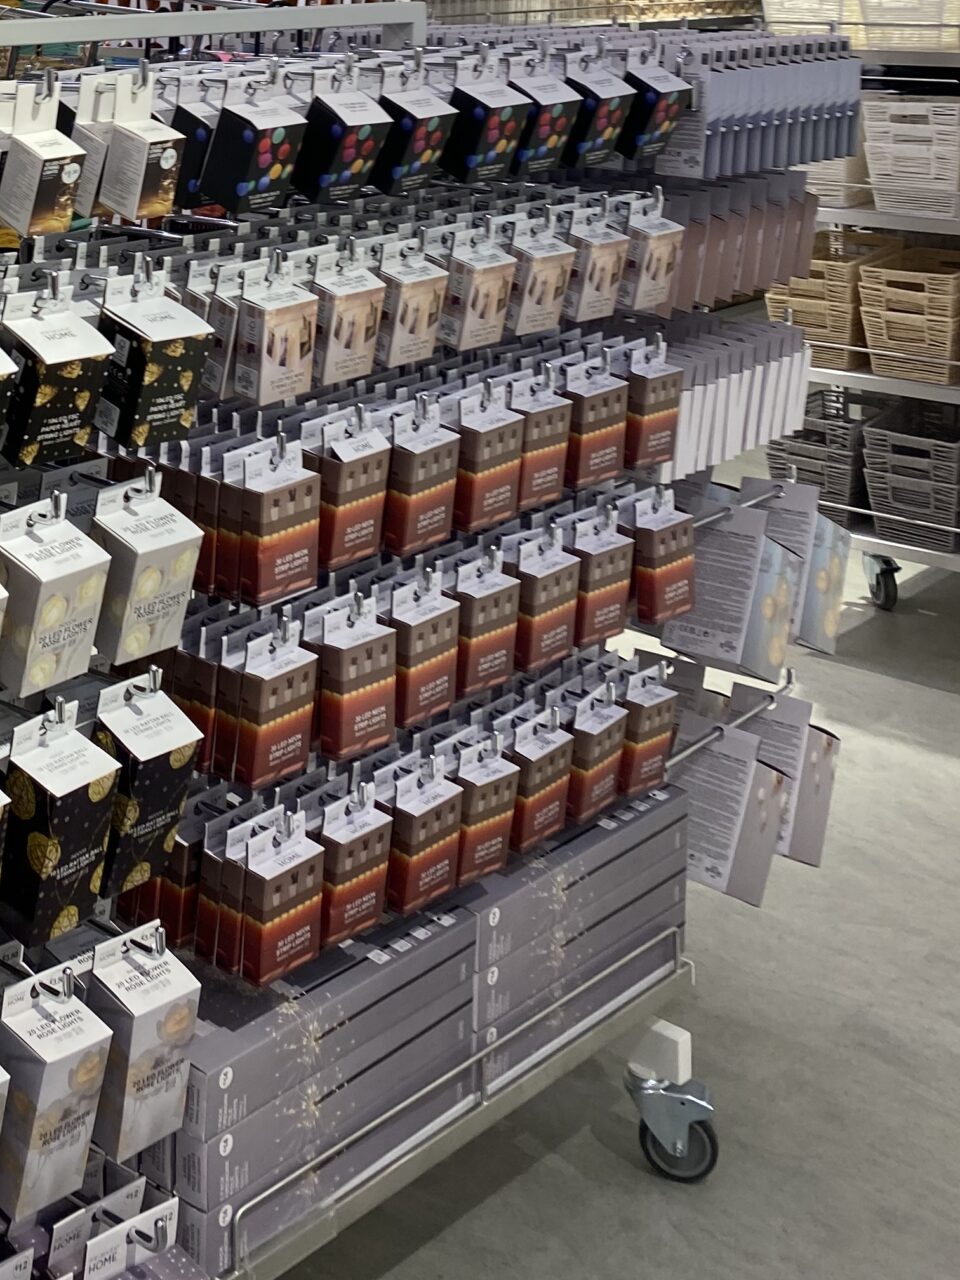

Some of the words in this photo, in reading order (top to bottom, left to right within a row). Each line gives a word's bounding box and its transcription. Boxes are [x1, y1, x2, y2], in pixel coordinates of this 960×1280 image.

[44, 329, 78, 343] HOME
[53, 1230, 83, 1252] HOME
[91, 1253, 118, 1273] HOME
